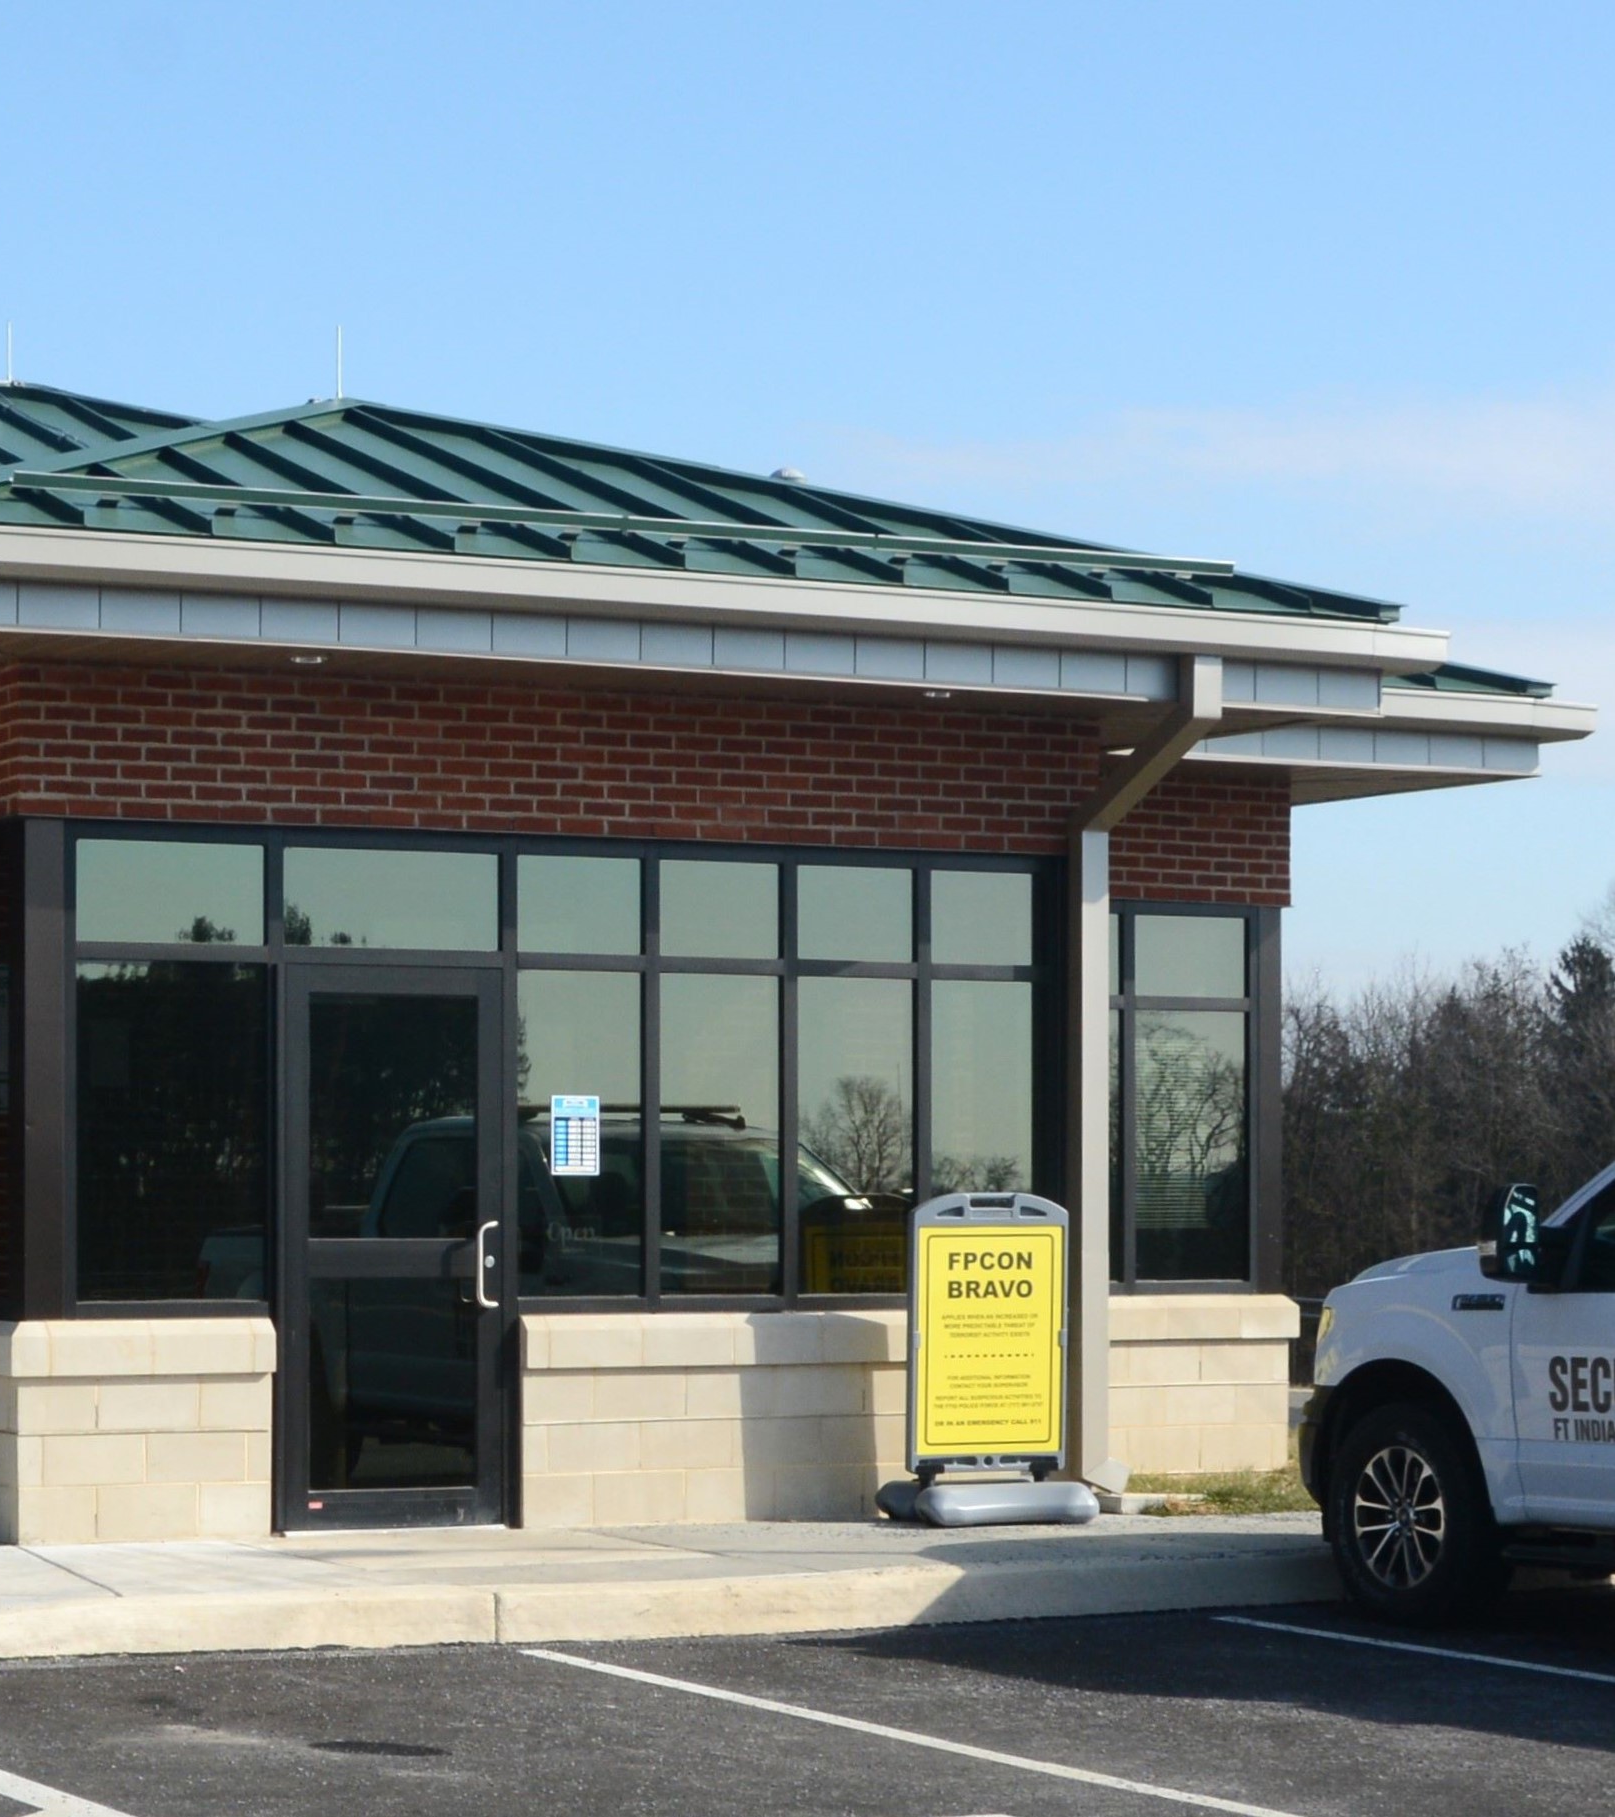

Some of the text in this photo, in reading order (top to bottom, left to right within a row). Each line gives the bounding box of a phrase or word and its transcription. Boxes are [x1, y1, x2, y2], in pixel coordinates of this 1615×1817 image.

[947, 1252, 1033, 1271] FPCON
[947, 1279, 1033, 1299] BRAVO
[1553, 1418, 1570, 1441] FT
